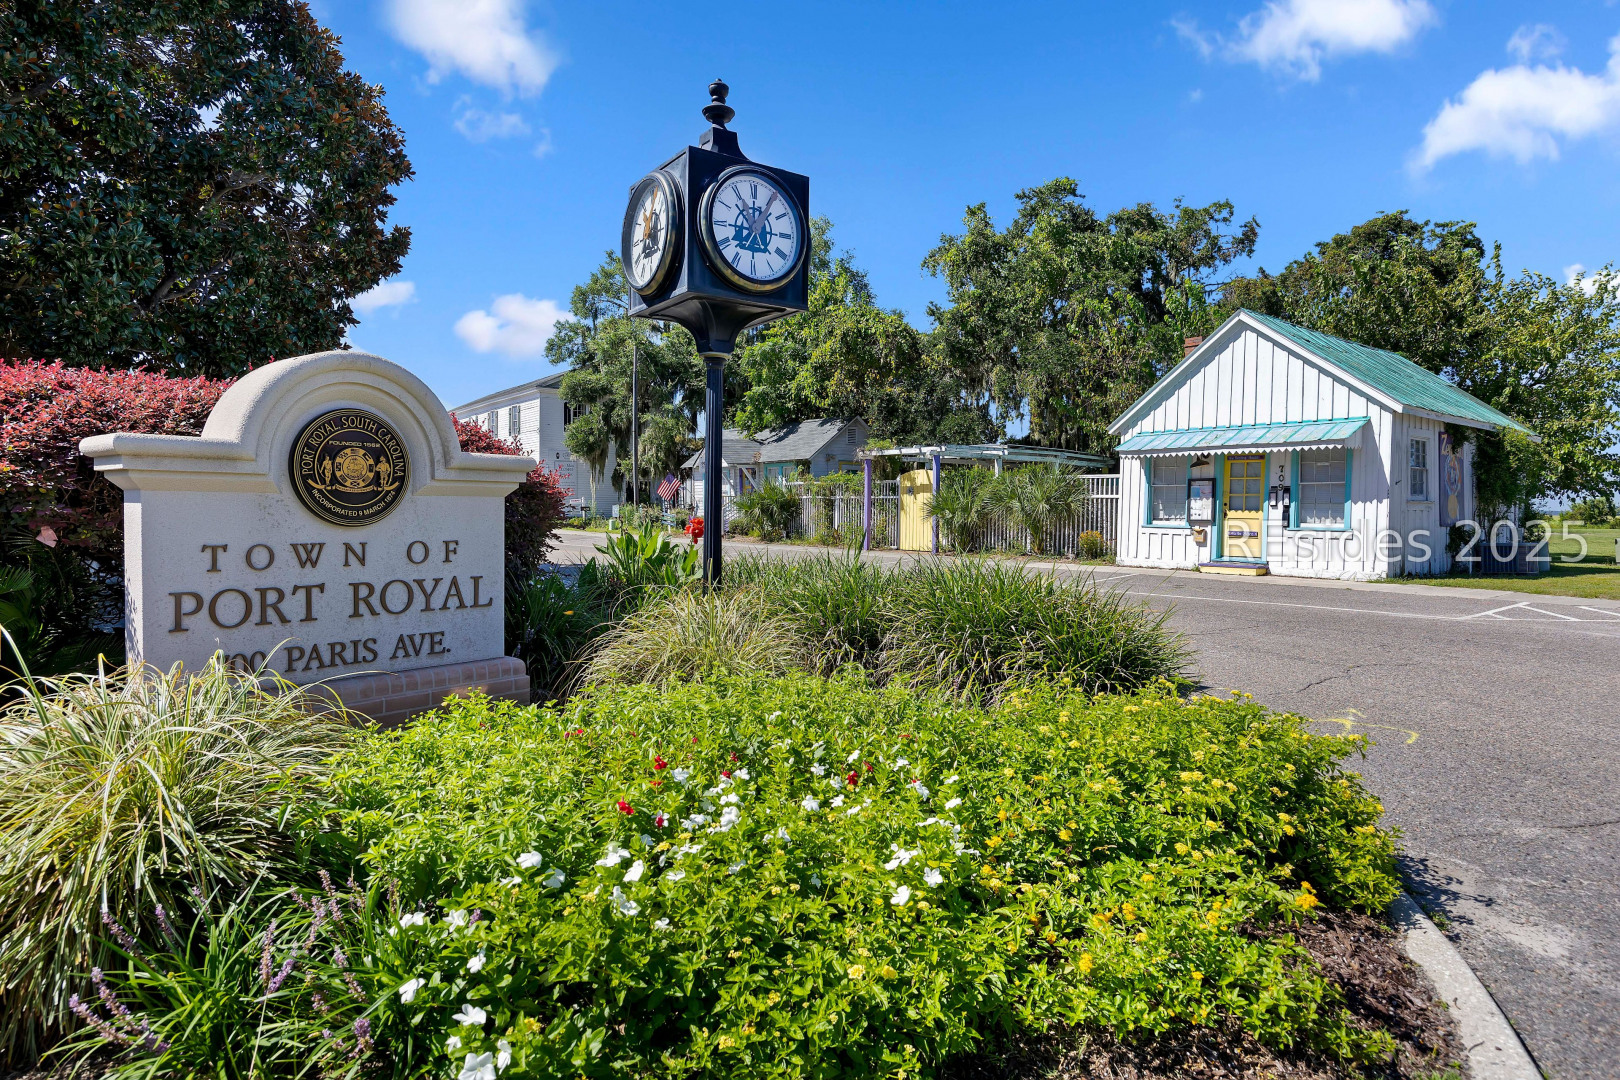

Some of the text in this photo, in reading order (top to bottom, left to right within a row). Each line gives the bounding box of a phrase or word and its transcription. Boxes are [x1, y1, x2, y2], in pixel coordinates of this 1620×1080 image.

[301, 446, 315, 475] PORT
[341, 416, 378, 433] SOUTH
[378, 428, 405, 477] CAROLINA
[311, 488, 358, 517] INCORPORATED
[363, 502, 386, 516] MARCH
[384, 490, 396, 504] 1874
[201, 539, 459, 573] TOWN OF
[168, 575, 493, 634] PORT ROYAL
[211, 631, 451, 678] 00 PARIS AVE.
